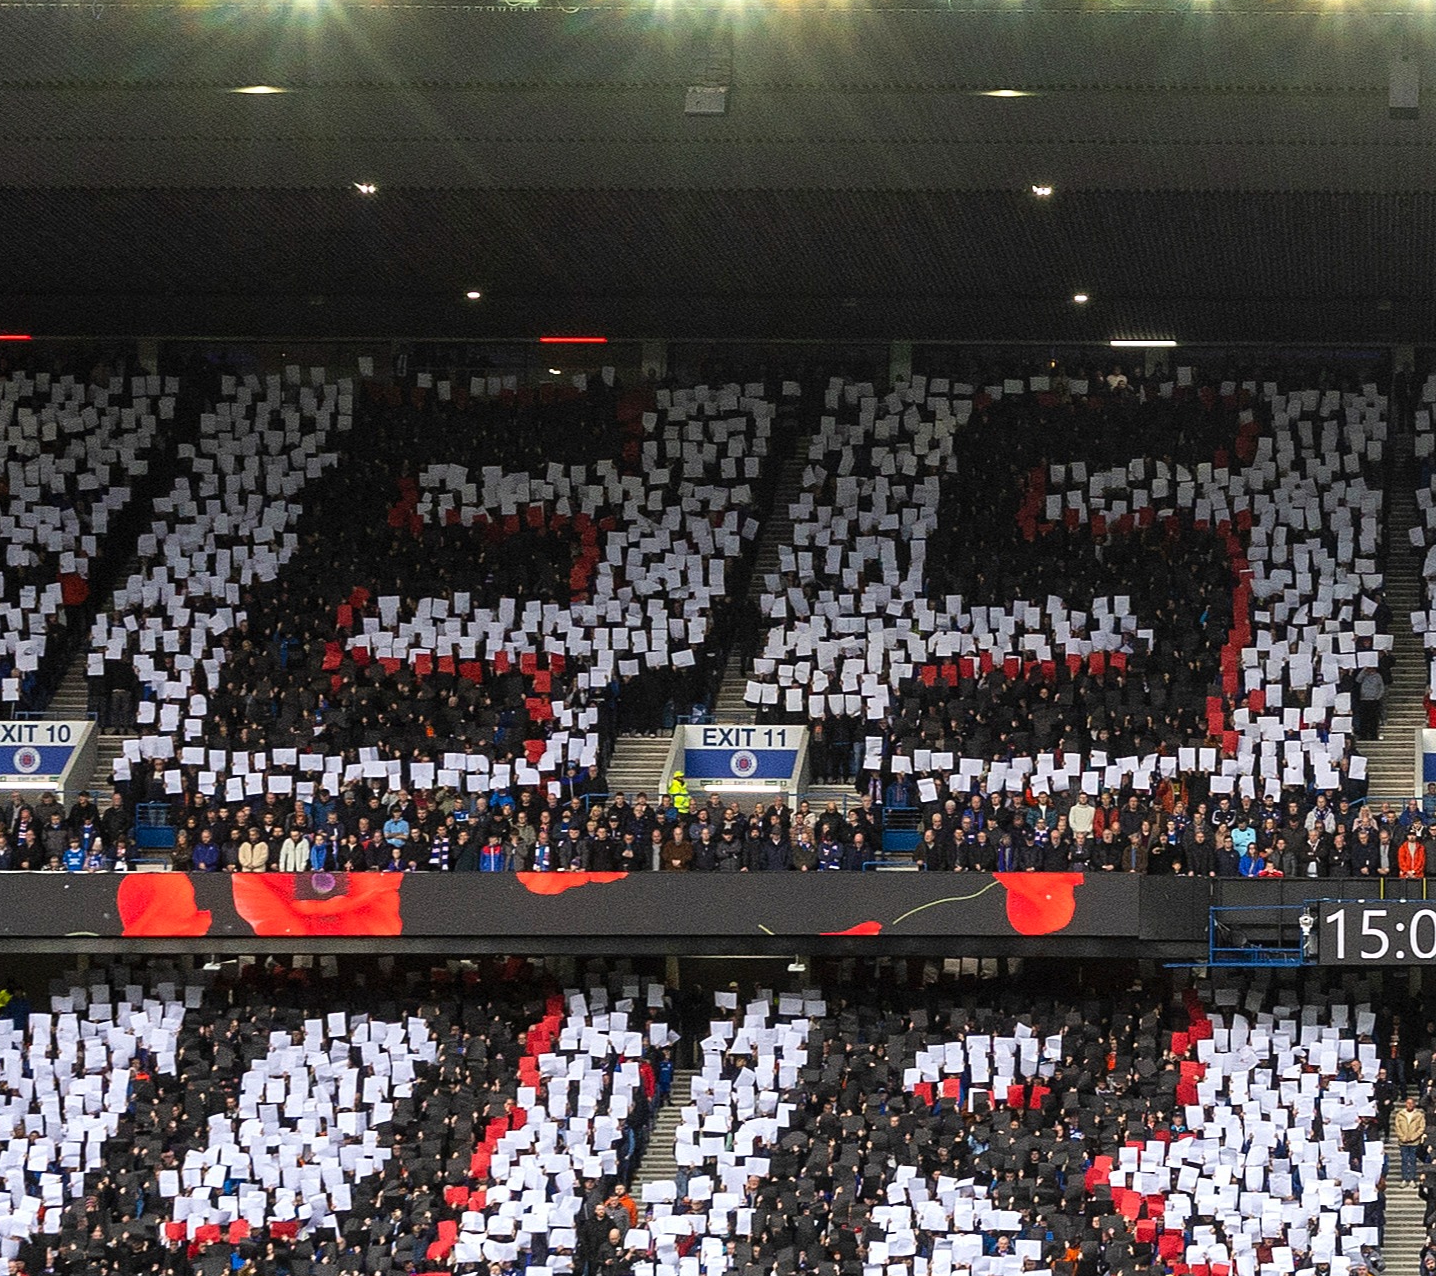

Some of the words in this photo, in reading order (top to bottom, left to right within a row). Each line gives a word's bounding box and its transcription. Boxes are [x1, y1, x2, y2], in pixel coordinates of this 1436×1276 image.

[46, 724, 71, 742] 10
[703, 728, 756, 746] EXIT
[764, 728, 786, 747] 11
